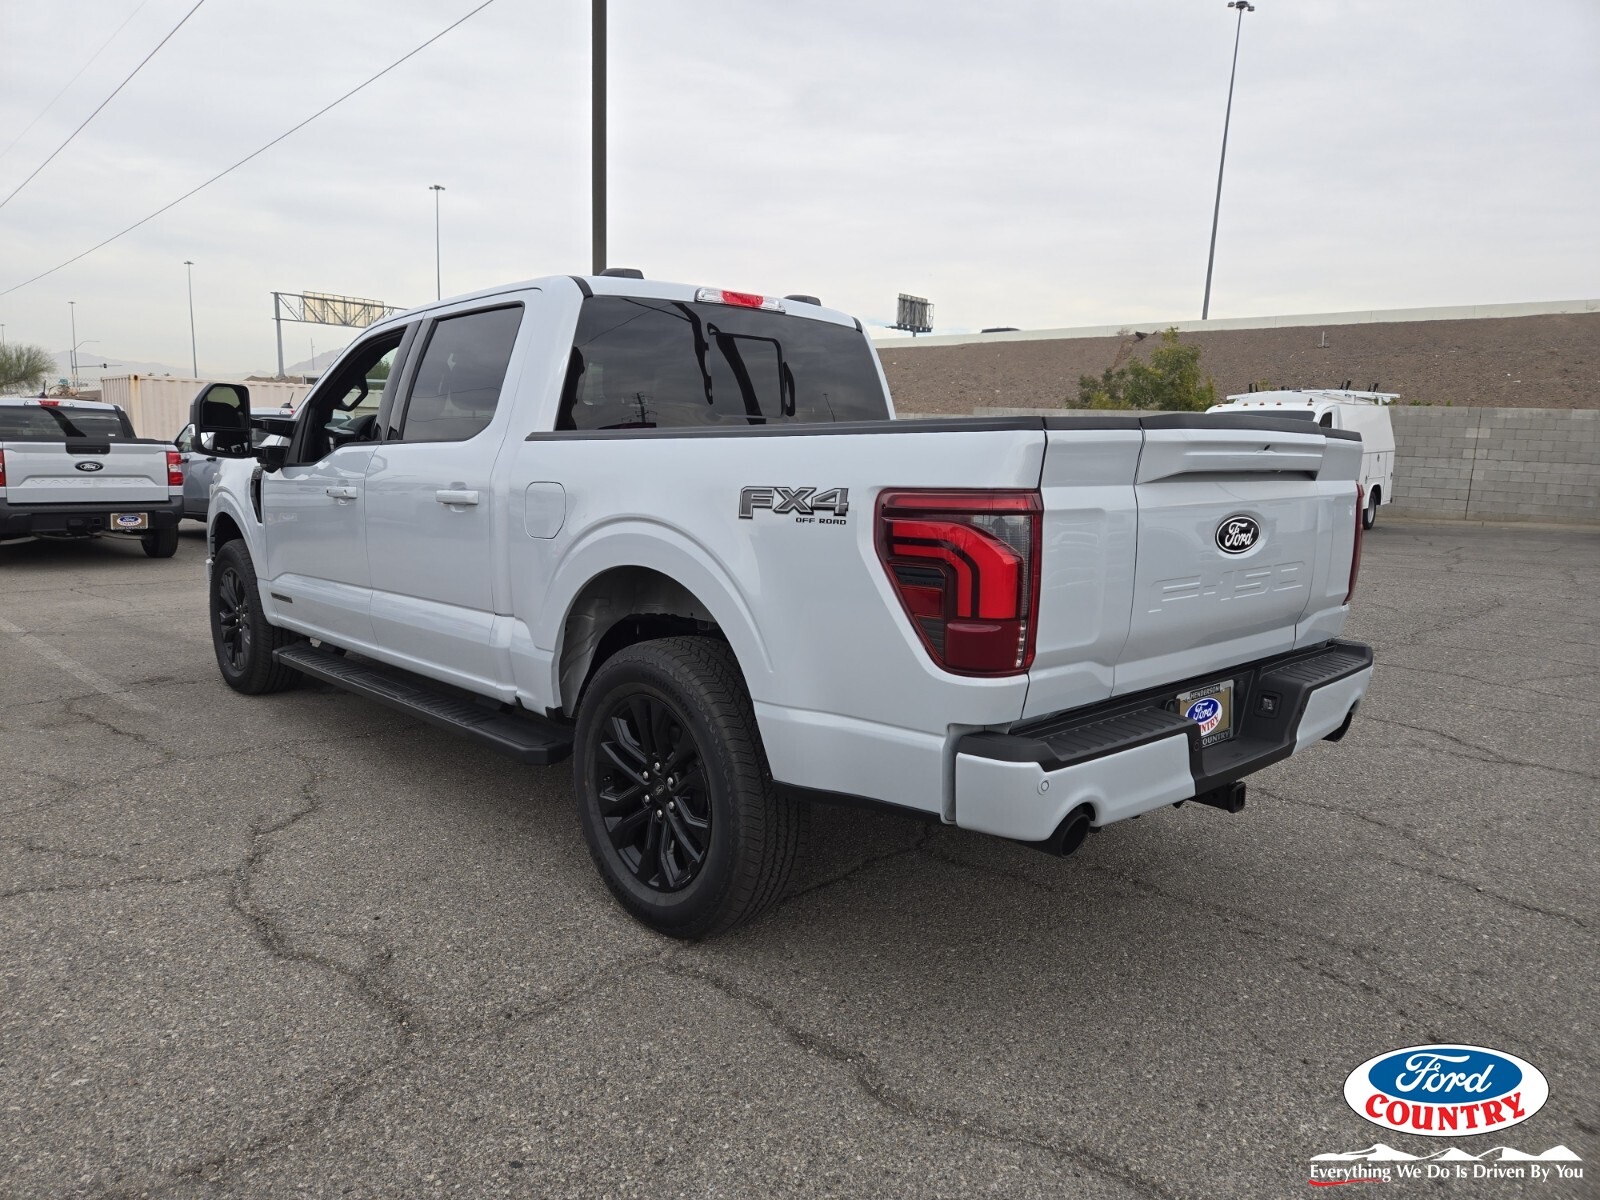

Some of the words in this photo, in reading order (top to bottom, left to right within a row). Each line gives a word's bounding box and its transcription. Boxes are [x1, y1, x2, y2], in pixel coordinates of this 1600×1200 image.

[739, 486, 849, 519] FX4
[1225, 521, 1254, 547] Ford
[1190, 685, 1220, 699] HENDERSON
[1192, 702, 1214, 720] Ford
[1200, 714, 1219, 733] NTRY
[1202, 732, 1230, 745] OUNTRY
